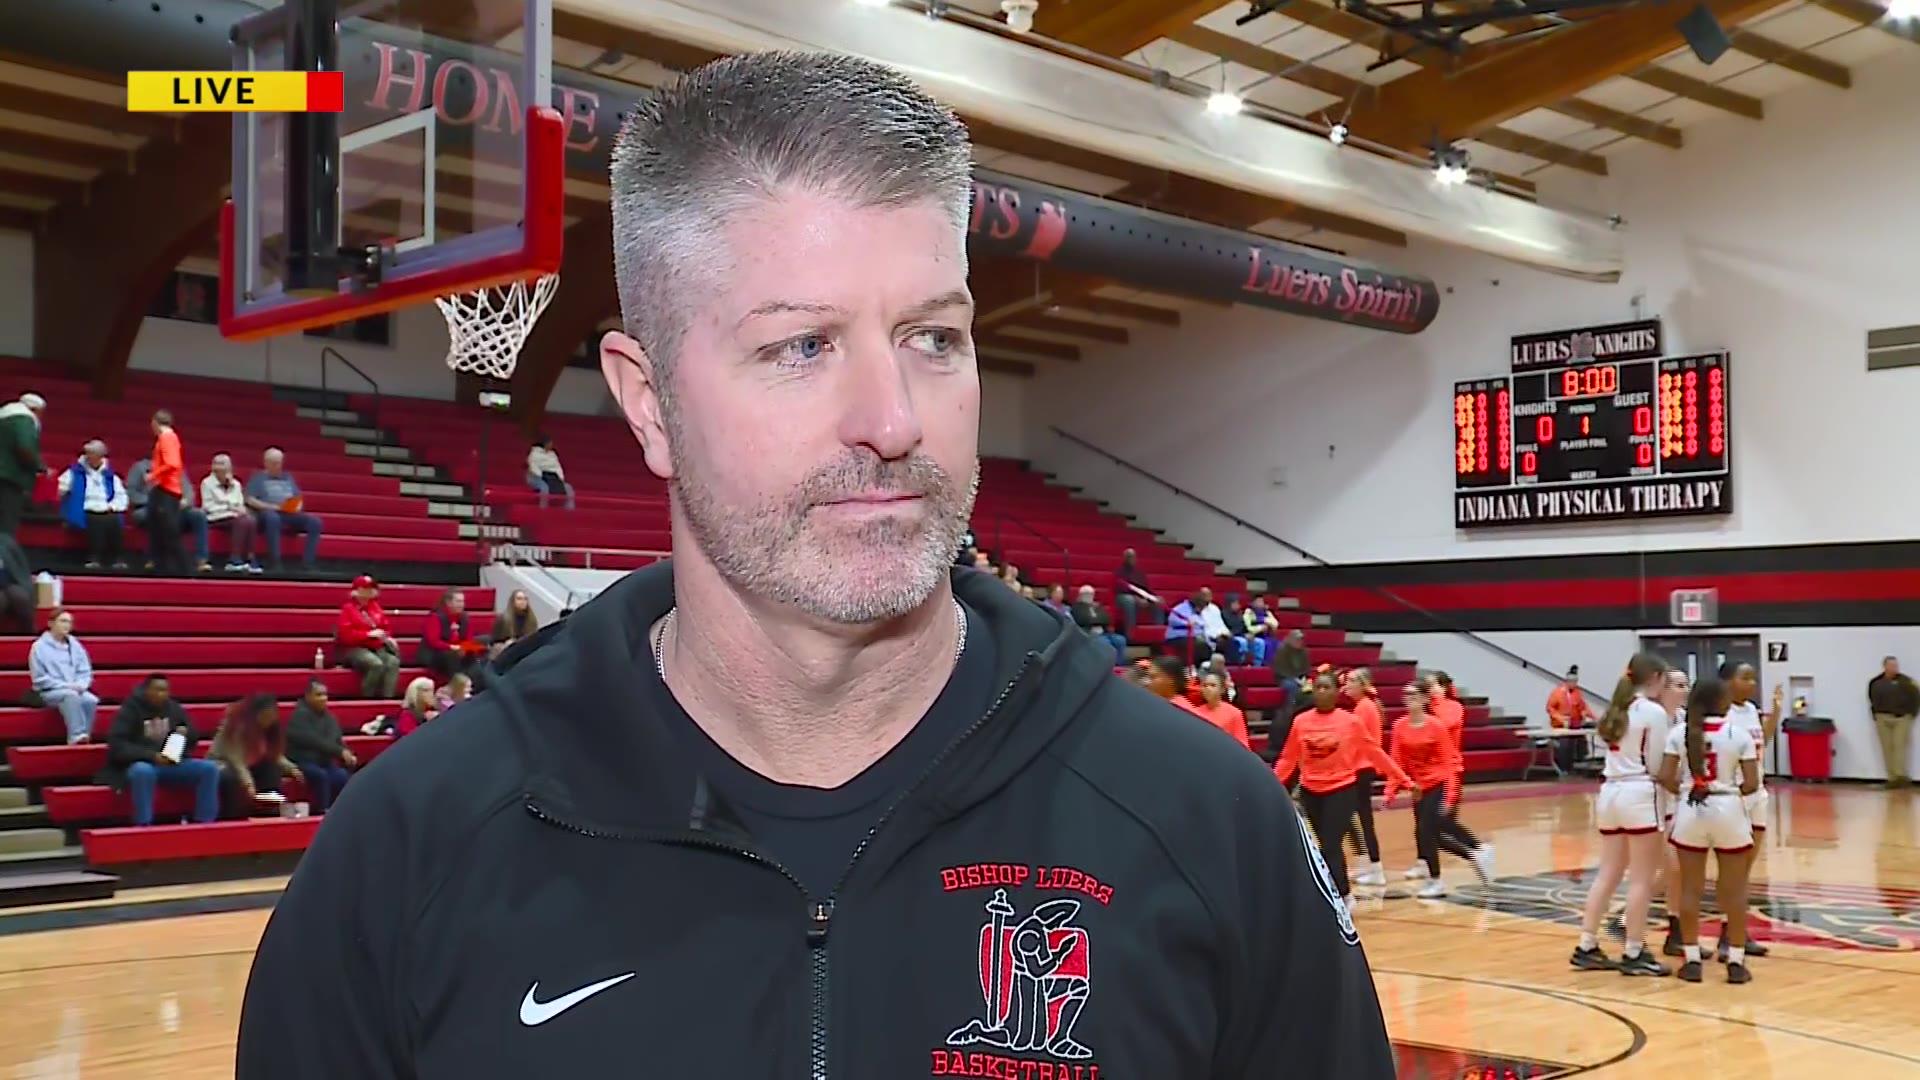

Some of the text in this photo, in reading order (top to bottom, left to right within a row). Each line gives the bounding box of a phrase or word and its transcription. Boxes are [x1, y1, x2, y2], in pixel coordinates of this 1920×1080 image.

[970, 181, 1021, 239] TS
[1243, 246, 1423, 322] Luers Spirit!
[1512, 328, 1656, 365] LUERS KNIGHTS
[1564, 367, 1616, 396] 8:00
[1514, 401, 1557, 416] KNIGHTS
[1613, 392, 1650, 407] GUEST
[1539, 416, 1553, 442] 0
[1636, 407, 1651, 433] 0
[1524, 452, 1536, 472] 0
[1638, 443, 1652, 464] 0
[1458, 480, 1725, 522] INDIANA PHYSICAL THERAPY
[940, 864, 1114, 905] BISHOP LUERS
[931, 1049, 1101, 1080] BASKETBALL
